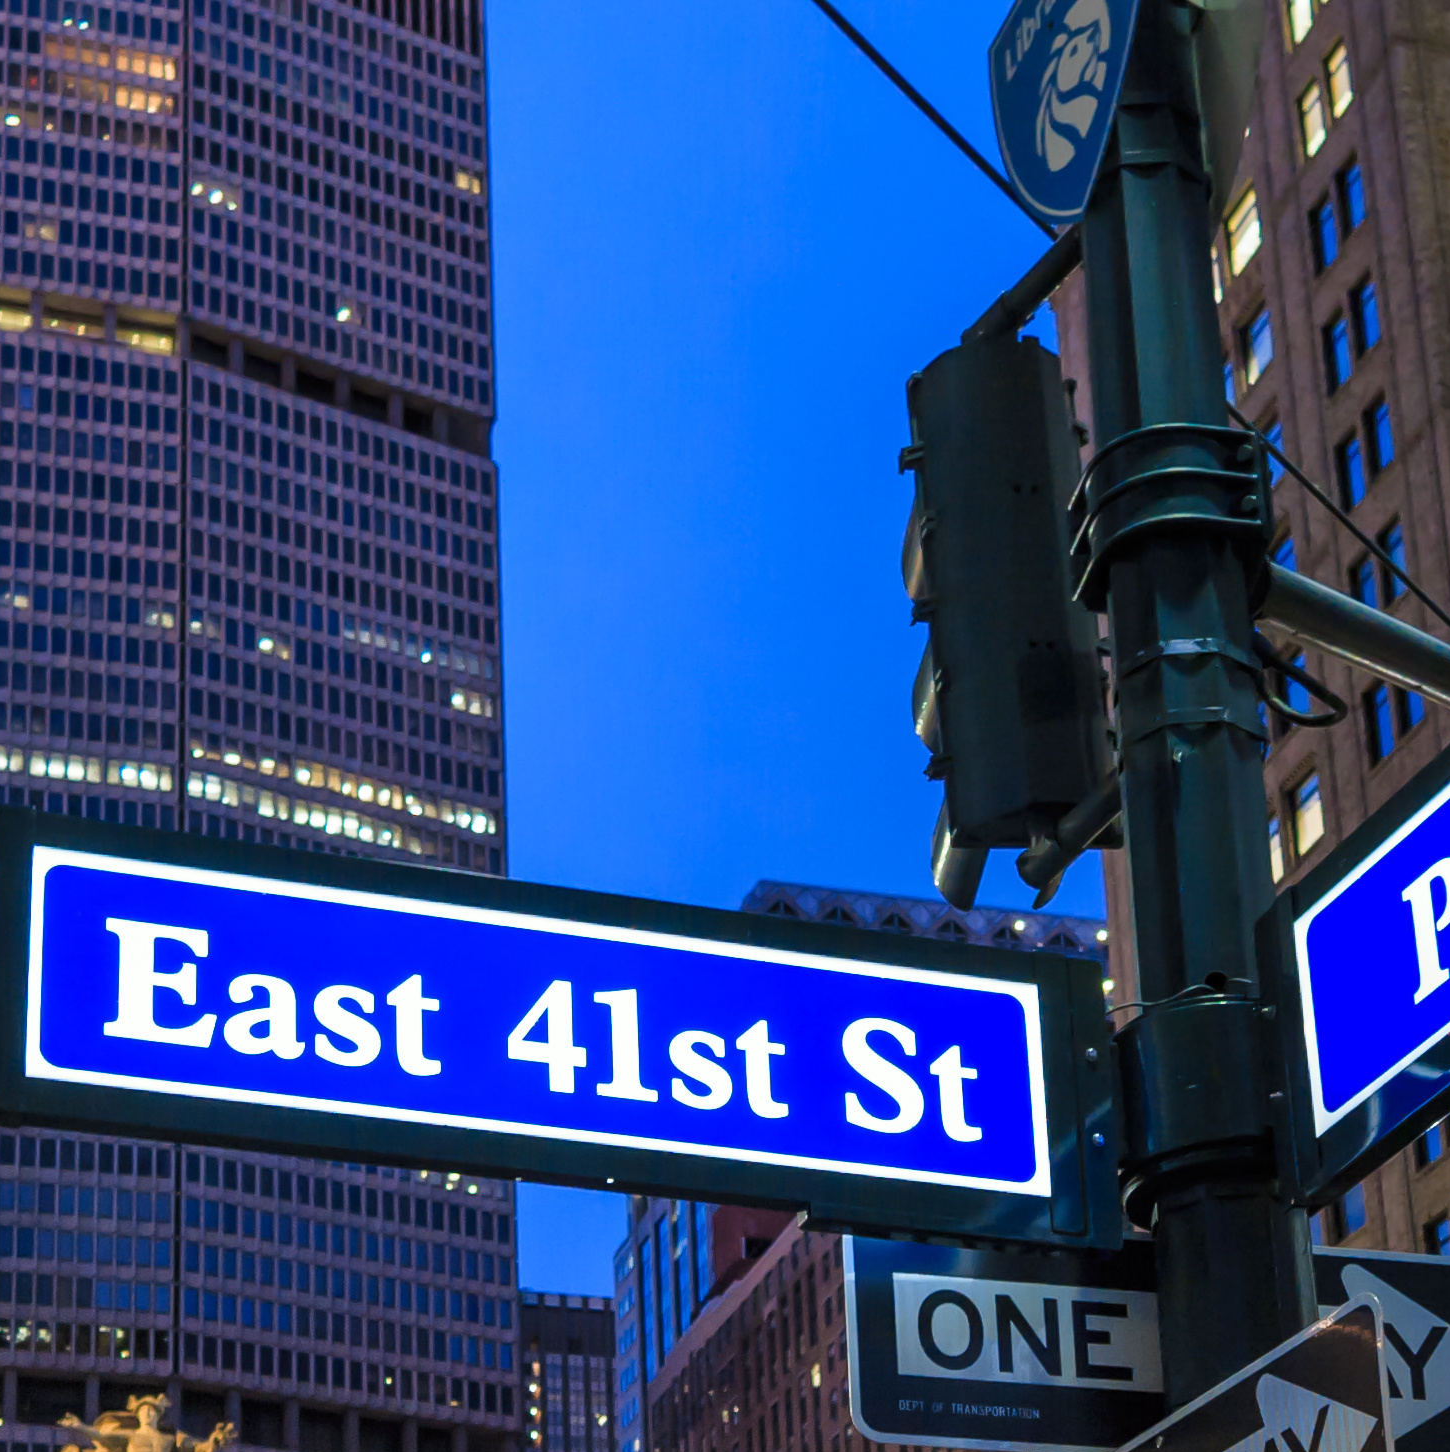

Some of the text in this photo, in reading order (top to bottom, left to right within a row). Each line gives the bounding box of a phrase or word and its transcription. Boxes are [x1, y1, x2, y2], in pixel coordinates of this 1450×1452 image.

[103, 917, 983, 1143] East 41st St
[917, 1288, 1135, 1382] ONE
[898, 1399, 925, 1412] DEPT
[951, 1402, 1041, 1419] TRANSPORTATION
